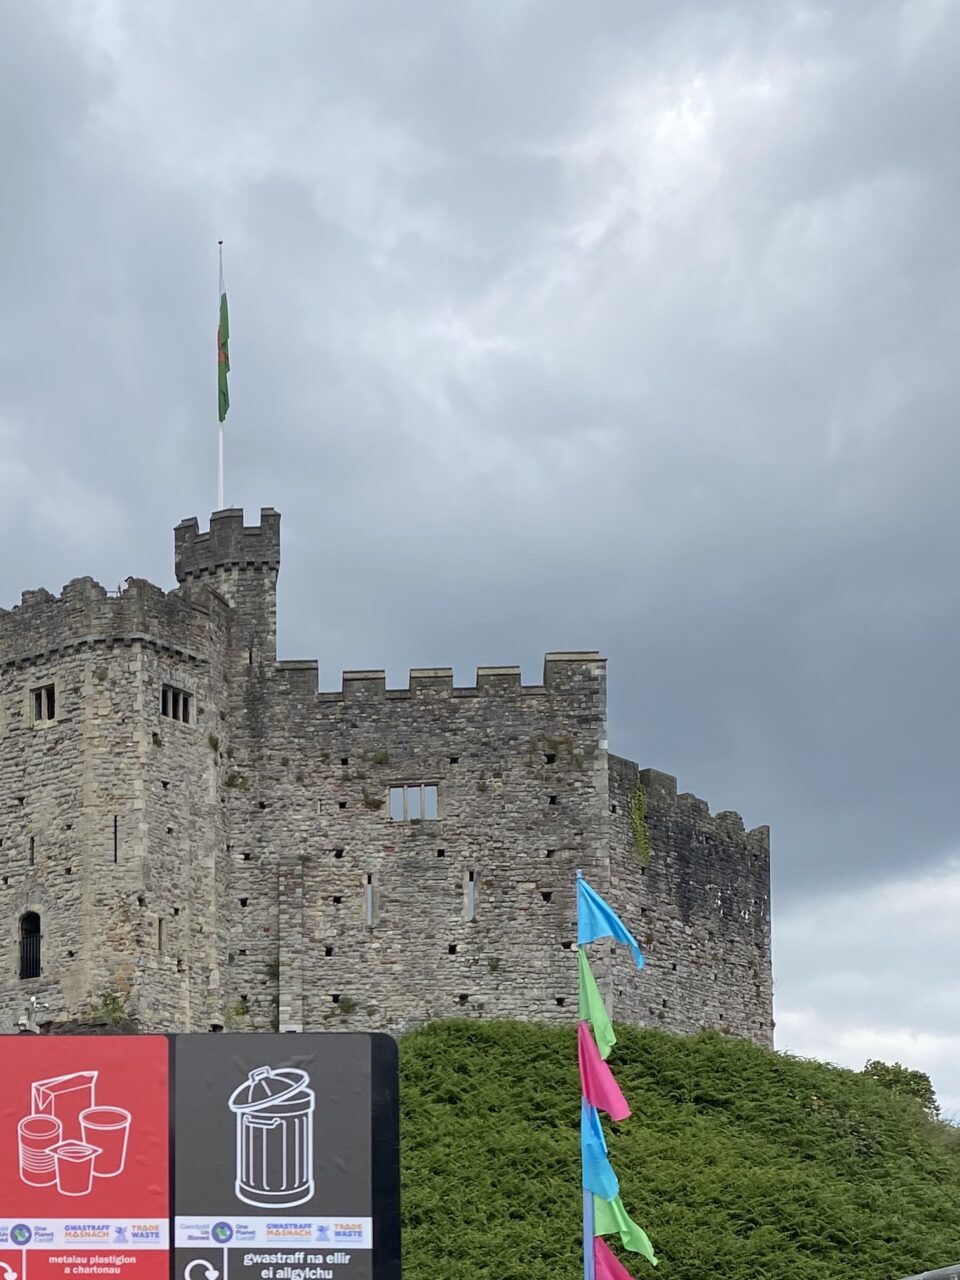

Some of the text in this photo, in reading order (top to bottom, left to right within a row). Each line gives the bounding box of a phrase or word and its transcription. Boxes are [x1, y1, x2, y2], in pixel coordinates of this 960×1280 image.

[48, 1255, 136, 1265] metalau plastigion
[243, 1252, 351, 1266] gwastraff na ellir
[72, 1266, 120, 1274] chartonau
[261, 1267, 333, 1280] ei ailgylchu
